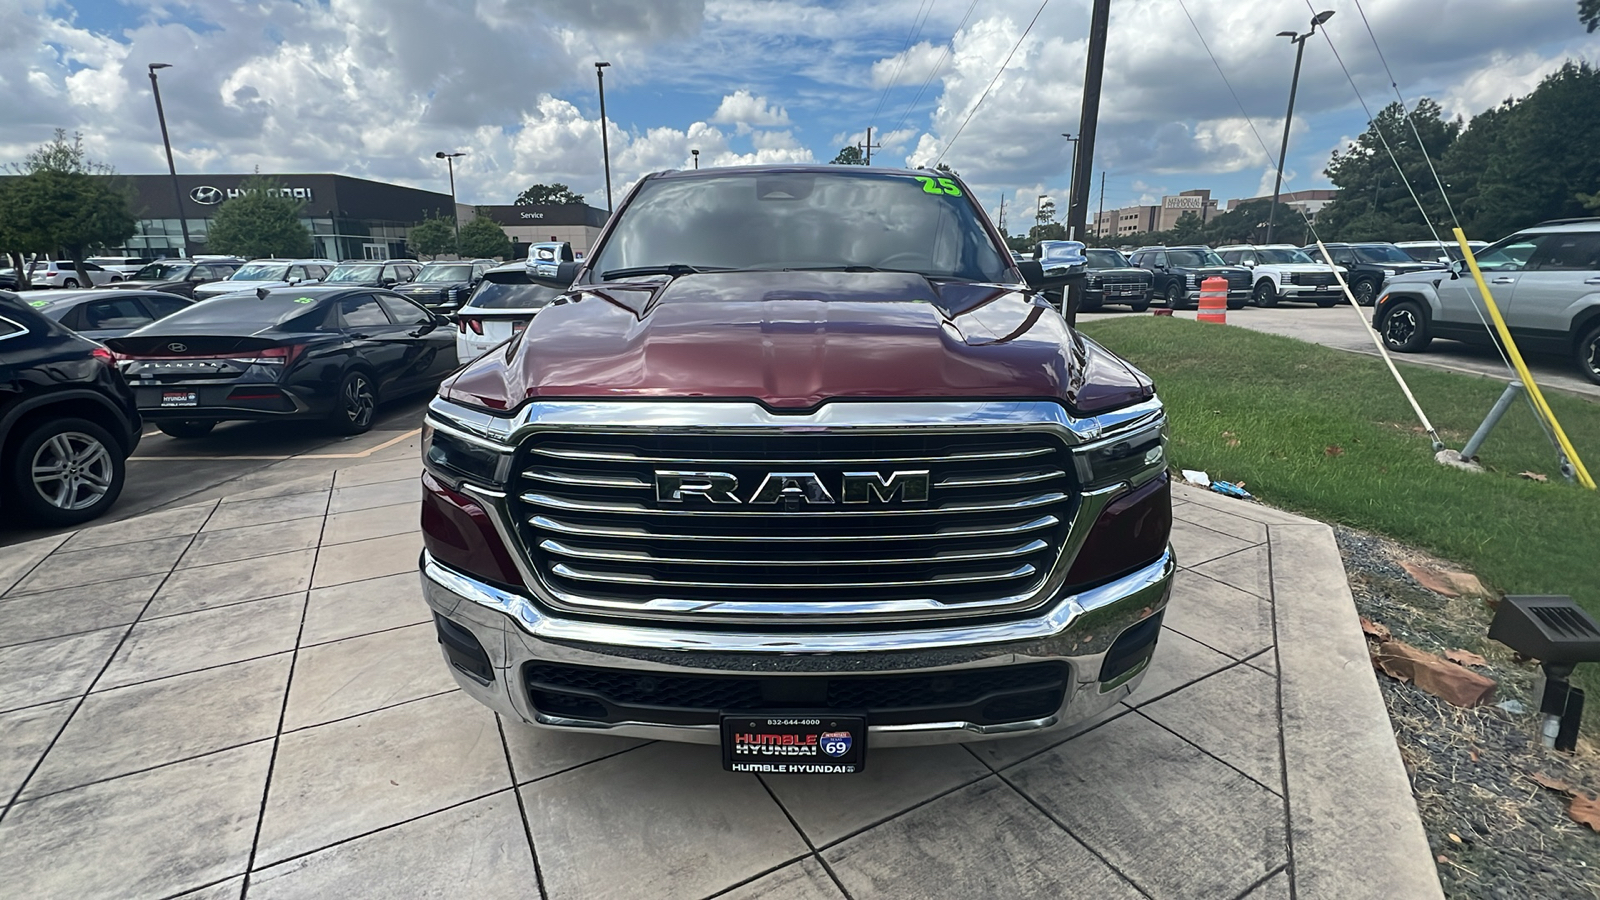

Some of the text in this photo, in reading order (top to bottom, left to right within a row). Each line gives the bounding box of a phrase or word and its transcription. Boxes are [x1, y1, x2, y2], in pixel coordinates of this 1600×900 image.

[914, 176, 962, 197] 25
[227, 188, 312, 201] HYNDAI
[655, 469, 930, 504] RAM
[735, 733, 818, 745] HUMBLE
[736, 745, 817, 755] HYUNDAI
[825, 742, 847, 753] 69
[732, 763, 787, 772] HUMBLE
[789, 764, 846, 773] HYUNDAI
